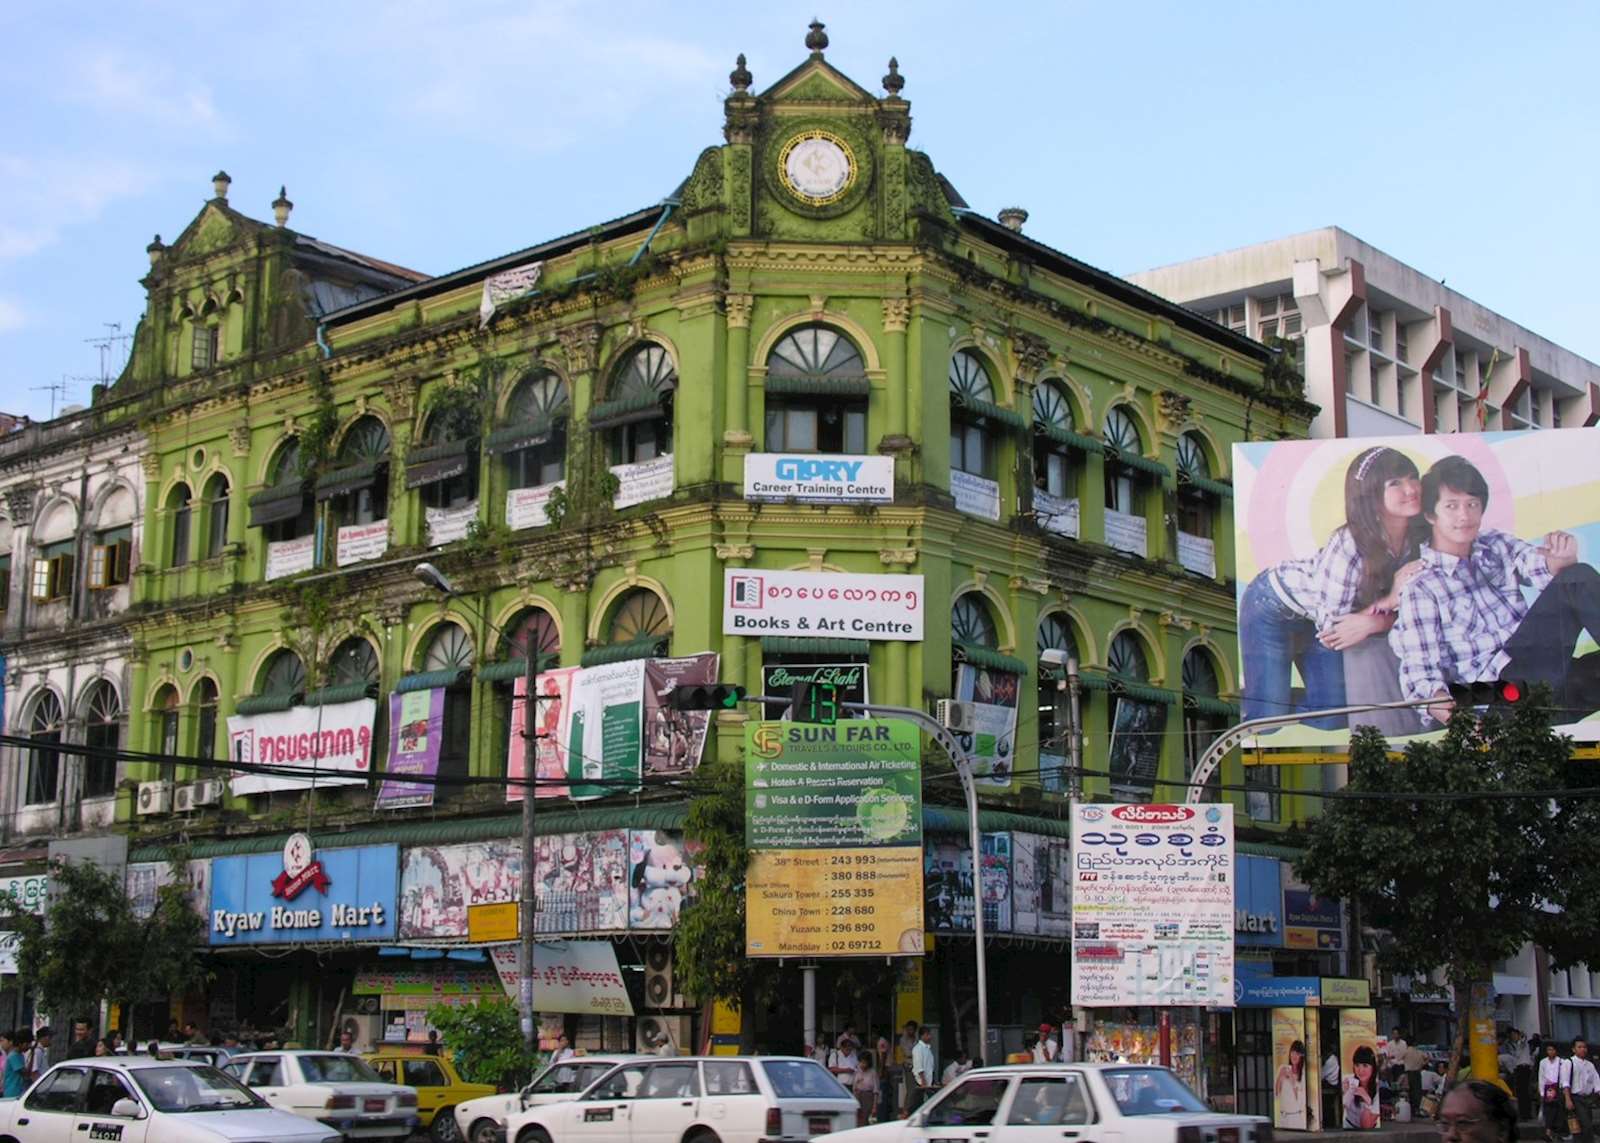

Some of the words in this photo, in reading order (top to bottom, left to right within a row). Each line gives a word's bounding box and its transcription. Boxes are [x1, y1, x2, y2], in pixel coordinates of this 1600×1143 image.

[776, 458, 864, 482] GLORY
[753, 482, 792, 493] Career
[796, 483, 843, 496] Training
[847, 484, 886, 495] Centre
[734, 614, 790, 630] Books
[797, 617, 810, 631] &
[817, 617, 845, 632] Art
[852, 618, 913, 634] Centre
[769, 668, 818, 687] Eternal
[788, 726, 836, 743] SUN
[846, 725, 890, 742] FAR
[839, 743, 873, 751] TOURS
[771, 762, 808, 771] Domestic
[809, 762, 817, 771] &
[818, 761, 868, 771] International
[869, 761, 880, 770] Air
[881, 760, 916, 771] Ticketing
[771, 777, 796, 787] Hotels
[837, 776, 883, 786] Reservation
[771, 795, 788, 804] Visa
[789, 795, 797, 805] &
[835, 794, 879, 805] Application
[793, 857, 820, 866] Street
[831, 856, 851, 865] 243
[856, 856, 876, 865] 993
[831, 872, 851, 881] 380
[855, 871, 876, 881] 888
[762, 890, 793, 900] Sakura
[795, 890, 820, 899] Tower
[831, 889, 851, 898] 255
[853, 889, 874, 898] 335
[772, 907, 797, 916] China
[800, 907, 821, 916] Town
[831, 906, 851, 915] 228
[854, 906, 875, 915] 680
[213, 909, 263, 937] Kyaw
[271, 906, 321, 929] Home
[331, 902, 385, 926] Mart
[1235, 909, 1277, 933] Mart
[790, 925, 821, 934] Yuzana
[831, 923, 852, 933] 296
[854, 923, 875, 932] 890
[779, 942, 821, 952] Mandalay
[832, 941, 845, 950] 02
[848, 940, 881, 950] 69712
